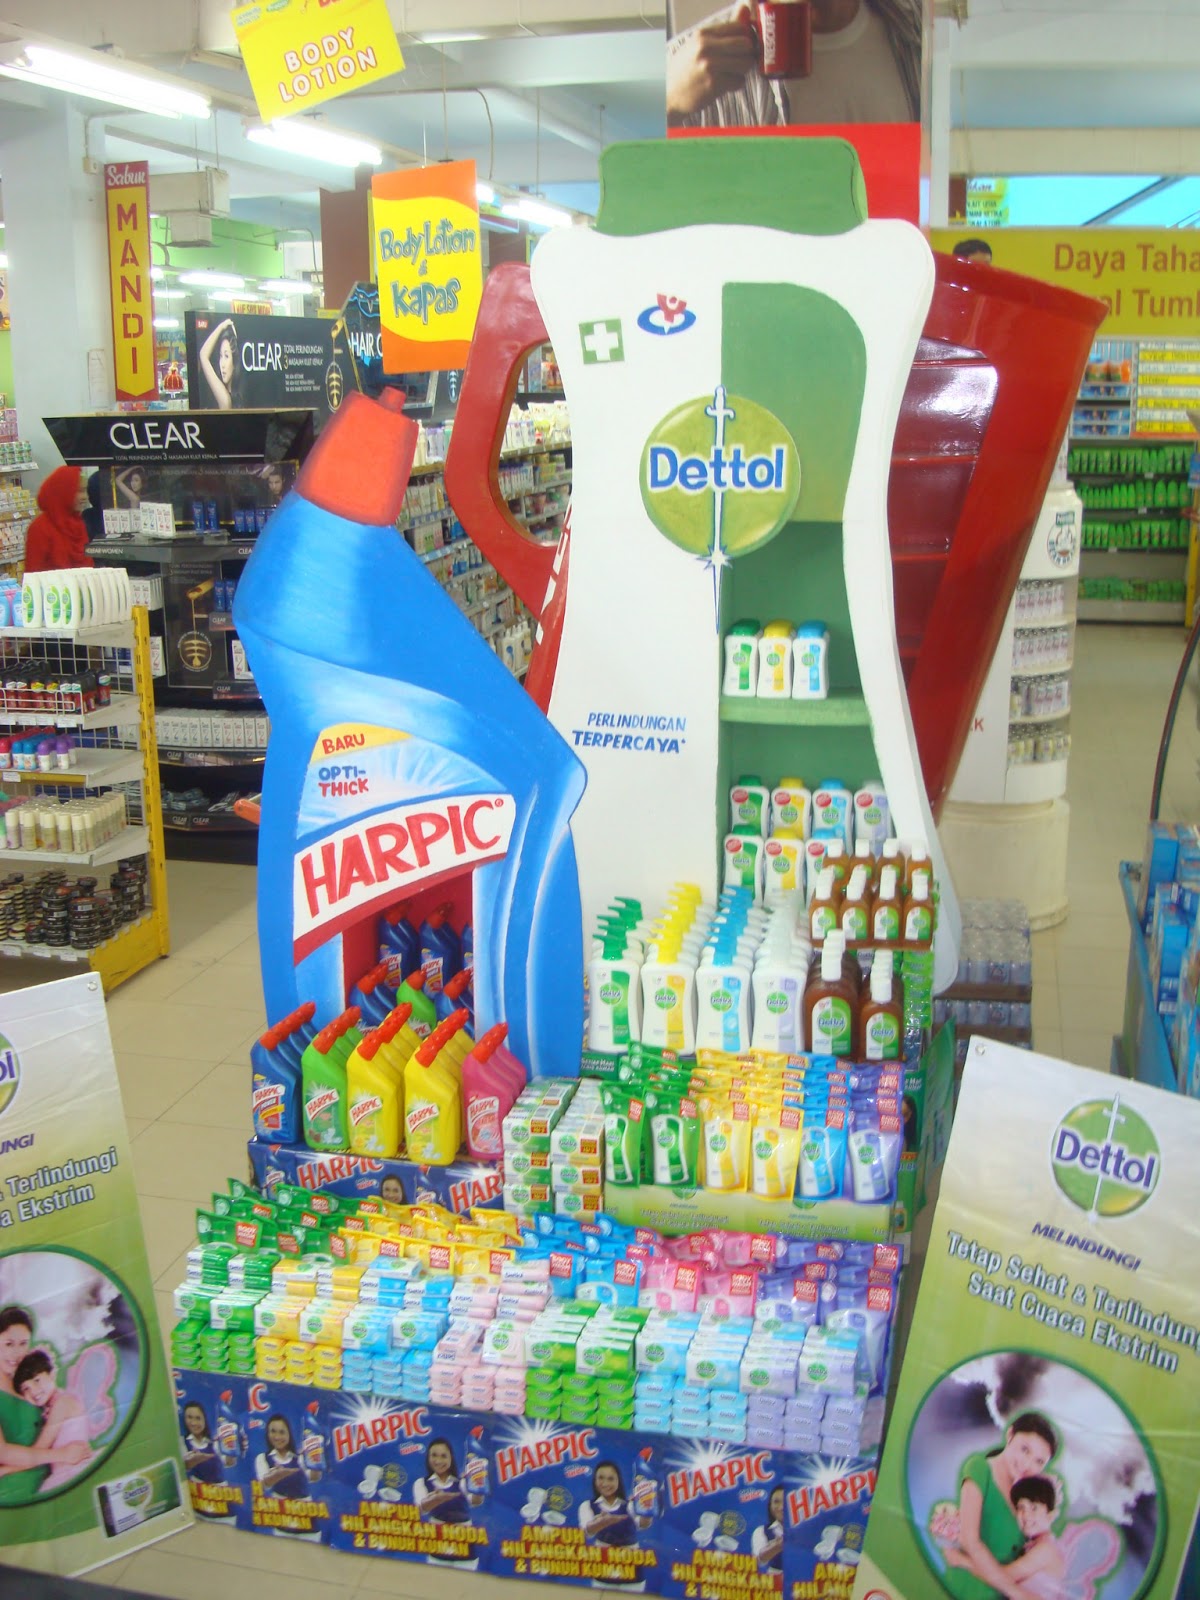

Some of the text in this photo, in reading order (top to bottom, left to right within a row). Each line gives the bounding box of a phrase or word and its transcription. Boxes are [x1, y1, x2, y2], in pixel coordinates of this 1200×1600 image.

[284, 26, 354, 73] BODY
[278, 46, 377, 103] LOTION
[107, 165, 146, 186] Sabun
[379, 218, 476, 265] Body Lotion
[1054, 243, 1200, 279] Daya Taha
[116, 203, 144, 374] MANDI
[391, 277, 461, 325] Kapas
[241, 342, 283, 372] CLEAR
[350, 331, 374, 357] HAIR
[283, 356, 289, 370] 3
[109, 422, 205, 450] CLEAR
[162, 452, 168, 461] 3
[649, 446, 785, 490] Dettol
[587, 712, 687, 731] PERLINDUNGAN
[321, 733, 365, 755] BARU
[572, 730, 686, 754] TERPERCAYA
[318, 766, 367, 781] OPTI-
[318, 777, 369, 797] THICK
[300, 800, 502, 919] HARPIC
[255, 1086, 281, 1101] HARPIC
[307, 1091, 335, 1112] HARPIC
[469, 1099, 496, 1116] HARPIC
[352, 1097, 379, 1119] HARPIC
[408, 1105, 436, 1126] HARPIC
[6, 1146, 119, 1198] Terlindungi
[297, 1156, 383, 1190] HARPIC
[1055, 1128, 1156, 1190] Dettol
[17, 1182, 96, 1223] Ekstrim
[450, 1171, 505, 1214] HAR
[1031, 1221, 1143, 1271] MELINDUNGI
[947, 1229, 1003, 1275] Tetap
[1006, 1254, 1069, 1299] Sehat
[1073, 1281, 1088, 1306] &
[967, 1271, 1179, 1375] Saat Cuaca Ekstrim
[333, 1406, 432, 1462] HARPIC
[495, 1428, 599, 1484] HARPIC
[668, 1451, 775, 1507] HARPIC
[359, 1501, 421, 1521] AMPUH
[787, 1468, 876, 1527] HARPI
[341, 1514, 489, 1544] HILANGKAN NODA
[521, 1525, 586, 1545] AMPUH
[418, 1538, 470, 1556] KUMAN
[501, 1540, 657, 1567] HILANGKAN NODA
[692, 1548, 758, 1573] AMPUH
[582, 1562, 636, 1580] KUMAN
[671, 1562, 775, 1589] HILANGKAN
[814, 1561, 857, 1583] AMP
